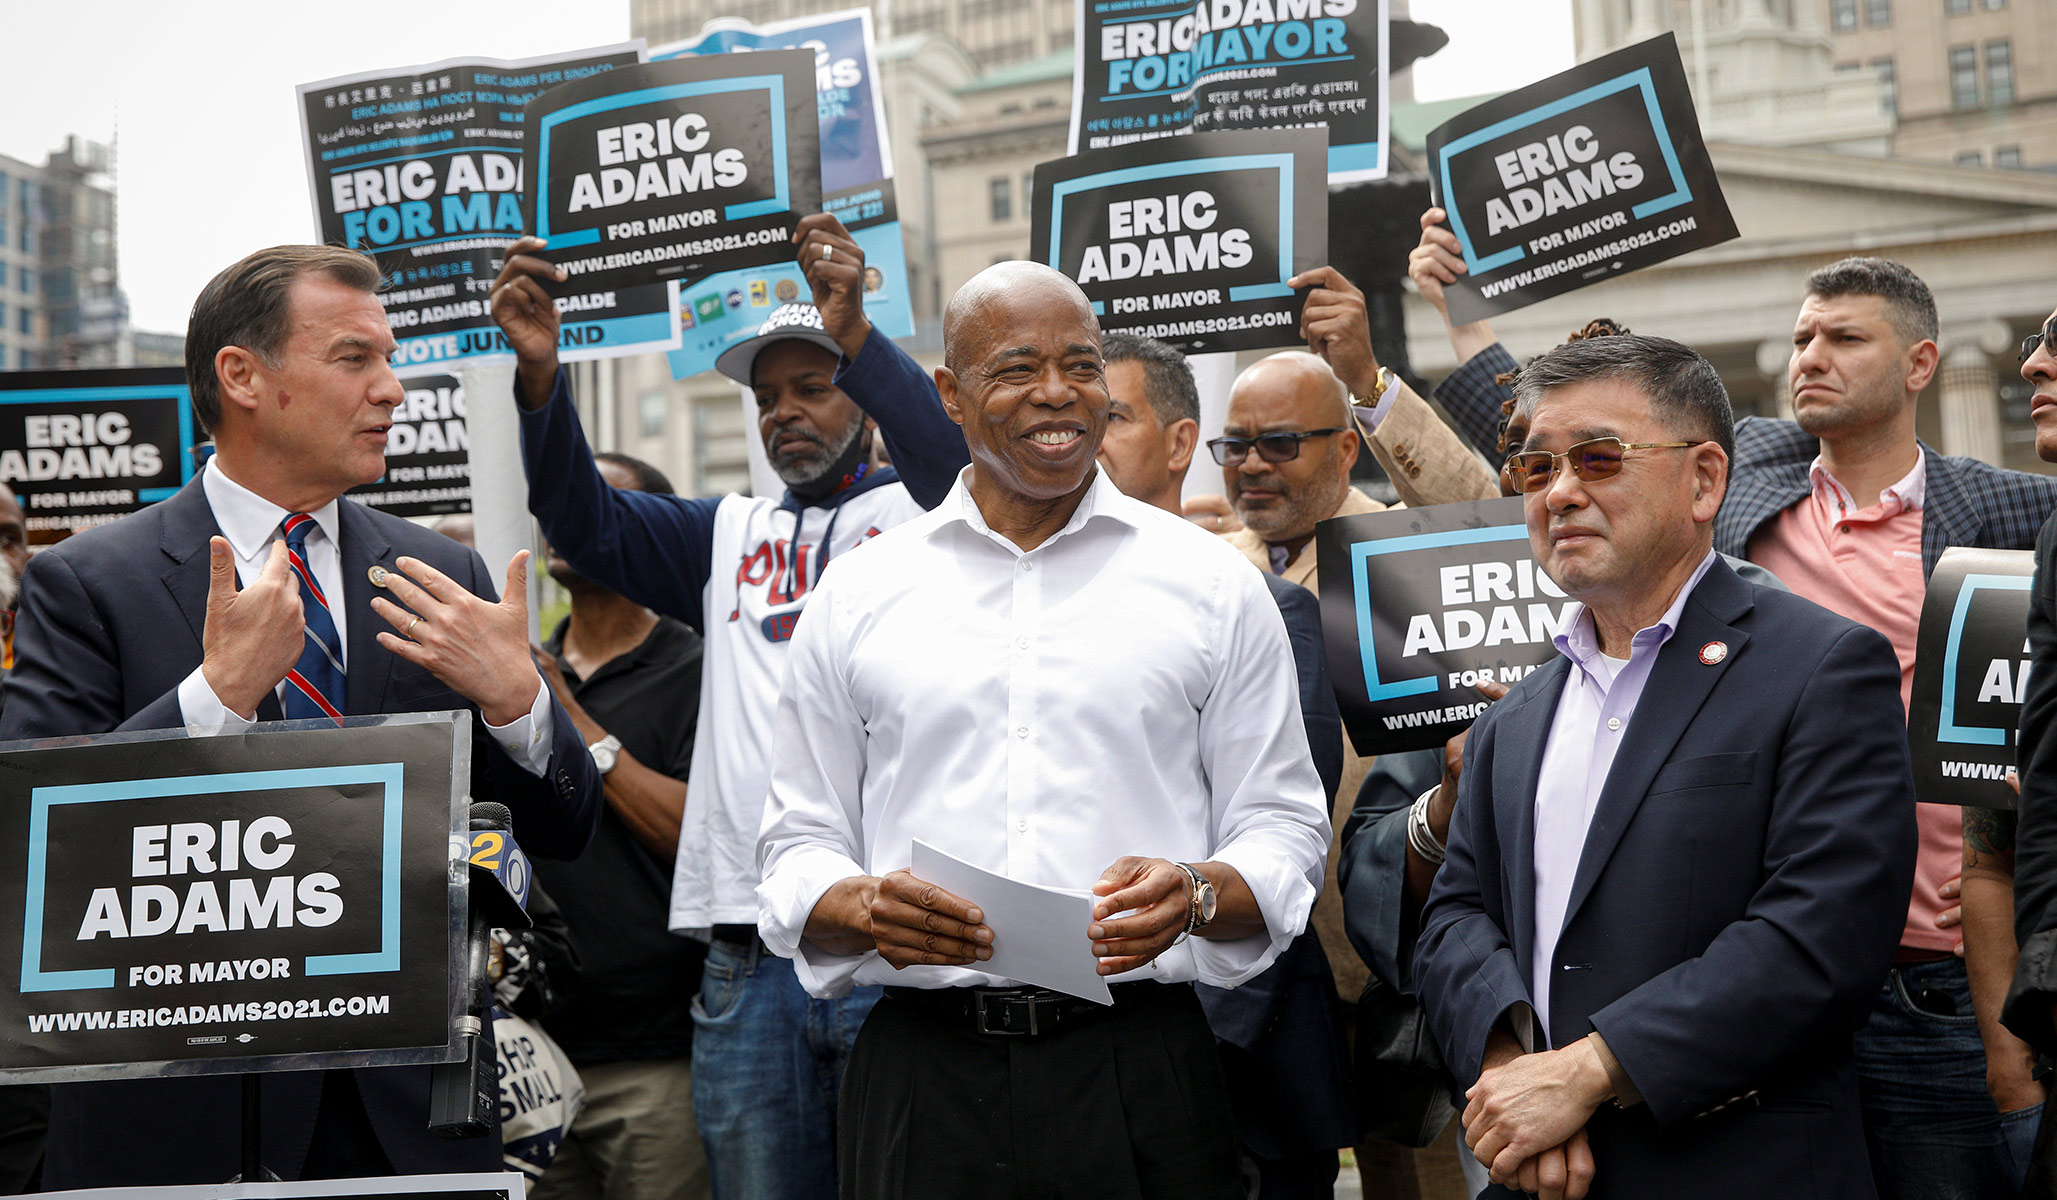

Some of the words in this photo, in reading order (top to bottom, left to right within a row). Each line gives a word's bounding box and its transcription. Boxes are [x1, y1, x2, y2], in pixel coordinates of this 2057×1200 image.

[1101, 14, 1195, 61] ERIC
[1194, 0, 1358, 39] ADAMS
[1107, 51, 1193, 94] FOR
[1191, 18, 1349, 77] MAYOR
[597, 113, 710, 166] ERIC
[1494, 124, 1599, 190] ERIC
[330, 159, 437, 214] ERIC
[568, 148, 748, 213] ADAMS
[1485, 151, 1645, 237] ADAMS
[343, 201, 435, 249] FOR
[607, 218, 646, 241] FOR
[648, 208, 718, 233] MAYOR
[1109, 190, 1218, 240] ERIC
[1528, 230, 1565, 255] FOR
[1566, 210, 1628, 243] MAYOR
[1077, 228, 1253, 284] ADAMS
[1480, 216, 1697, 300] WWW.ERICADAMS2021.COM
[420, 300, 483, 324] ADAMS
[1112, 297, 1150, 315] FOR
[1152, 289, 1221, 311] MAYOR
[390, 335, 460, 365] VOTE
[461, 326, 513, 354] JUN
[1100, 311, 1292, 339] ERICADAMS2021.COM
[24, 411, 132, 448] ERIC
[384, 420, 469, 457] DAM
[0, 443, 163, 482] ADAMS
[390, 467, 425, 482] FOR
[427, 464, 471, 480] MAYO
[30, 493, 68, 509] FOR
[69, 489, 134, 507] MAYOR
[771, 613, 800, 640] 19
[1402, 601, 1581, 658] ADAM
[1448, 668, 1494, 689] FOR
[1382, 701, 1495, 730] WWW.ERIC
[131, 815, 296, 877] ERIC
[76, 871, 344, 941] ADAMS
[129, 964, 183, 988] FOR
[189, 958, 291, 982] MAYOR
[28, 995, 390, 1034] WWW.ERICADAMS2021.COM
